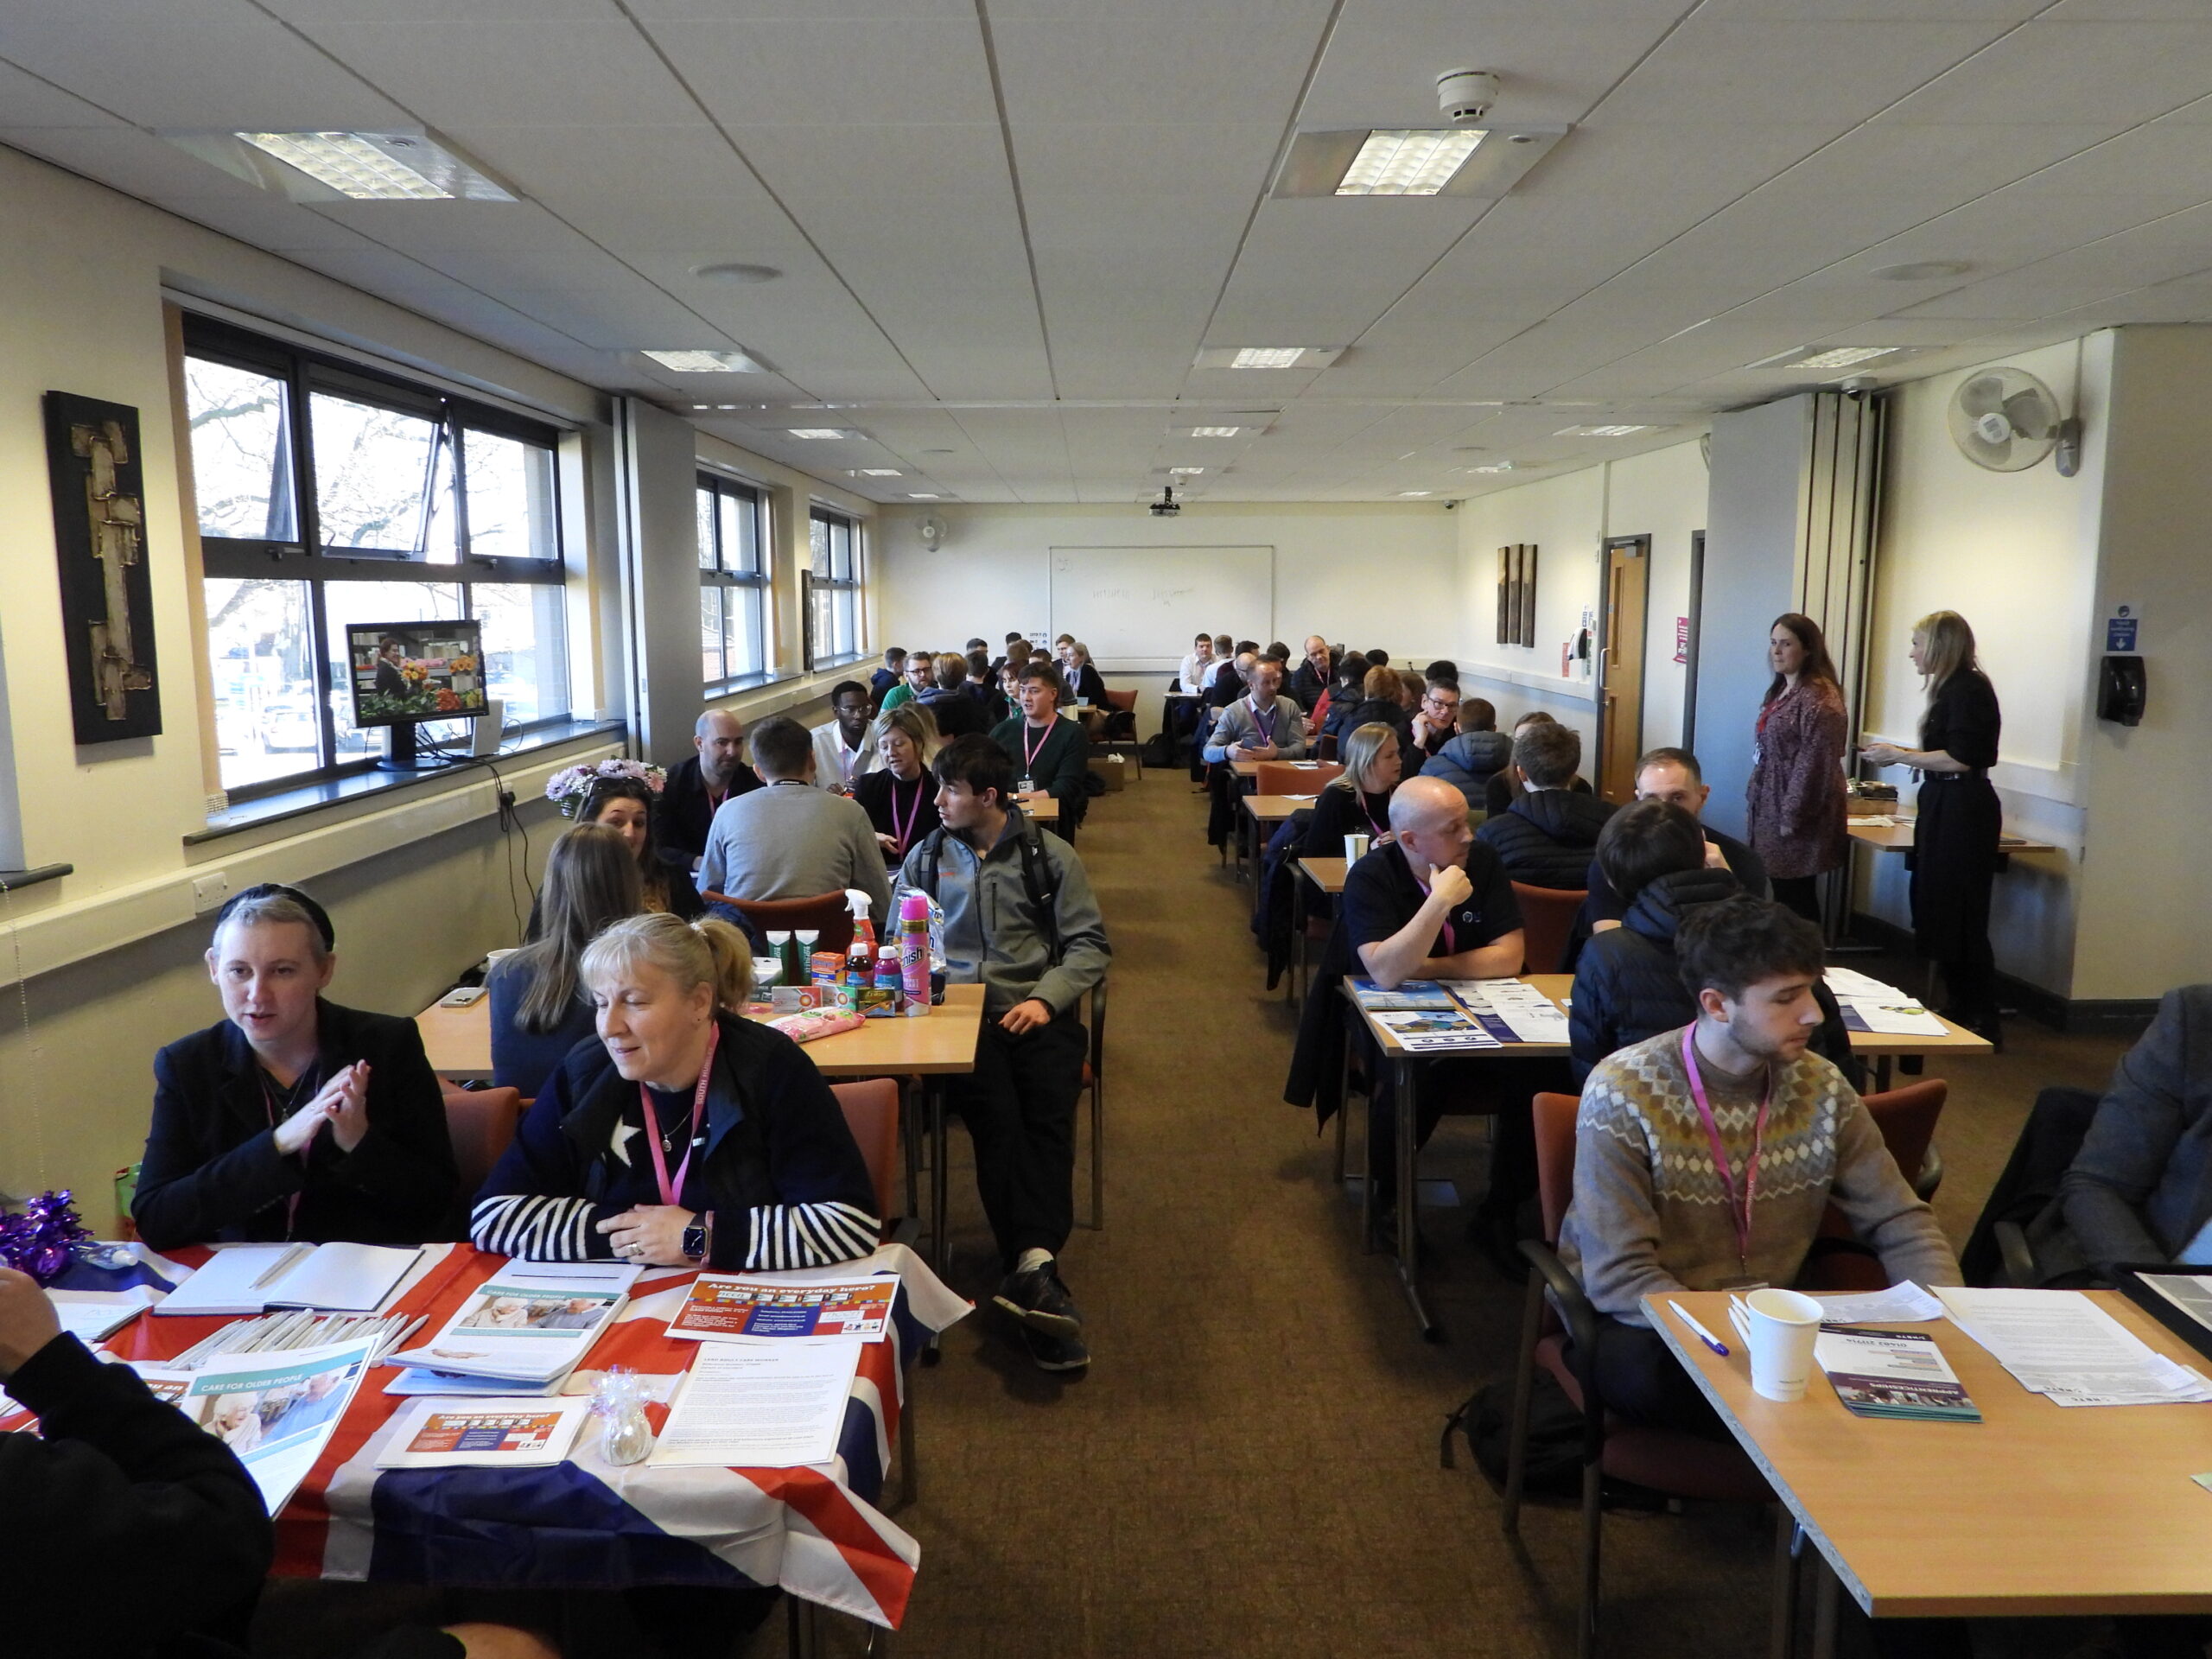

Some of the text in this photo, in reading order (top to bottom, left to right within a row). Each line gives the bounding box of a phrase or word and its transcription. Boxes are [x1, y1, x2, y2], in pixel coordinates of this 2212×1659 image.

[902, 946, 923, 969] nish
[697, 1079, 708, 1105] SOUTH
[779, 1285, 838, 1294] everyday
[201, 1383, 224, 1392] CARE
[246, 1379, 270, 1389] OLDER
[271, 1374, 304, 1385] PEOPLE
[1869, 1382, 1959, 1395] APPRENTICESHIPS
